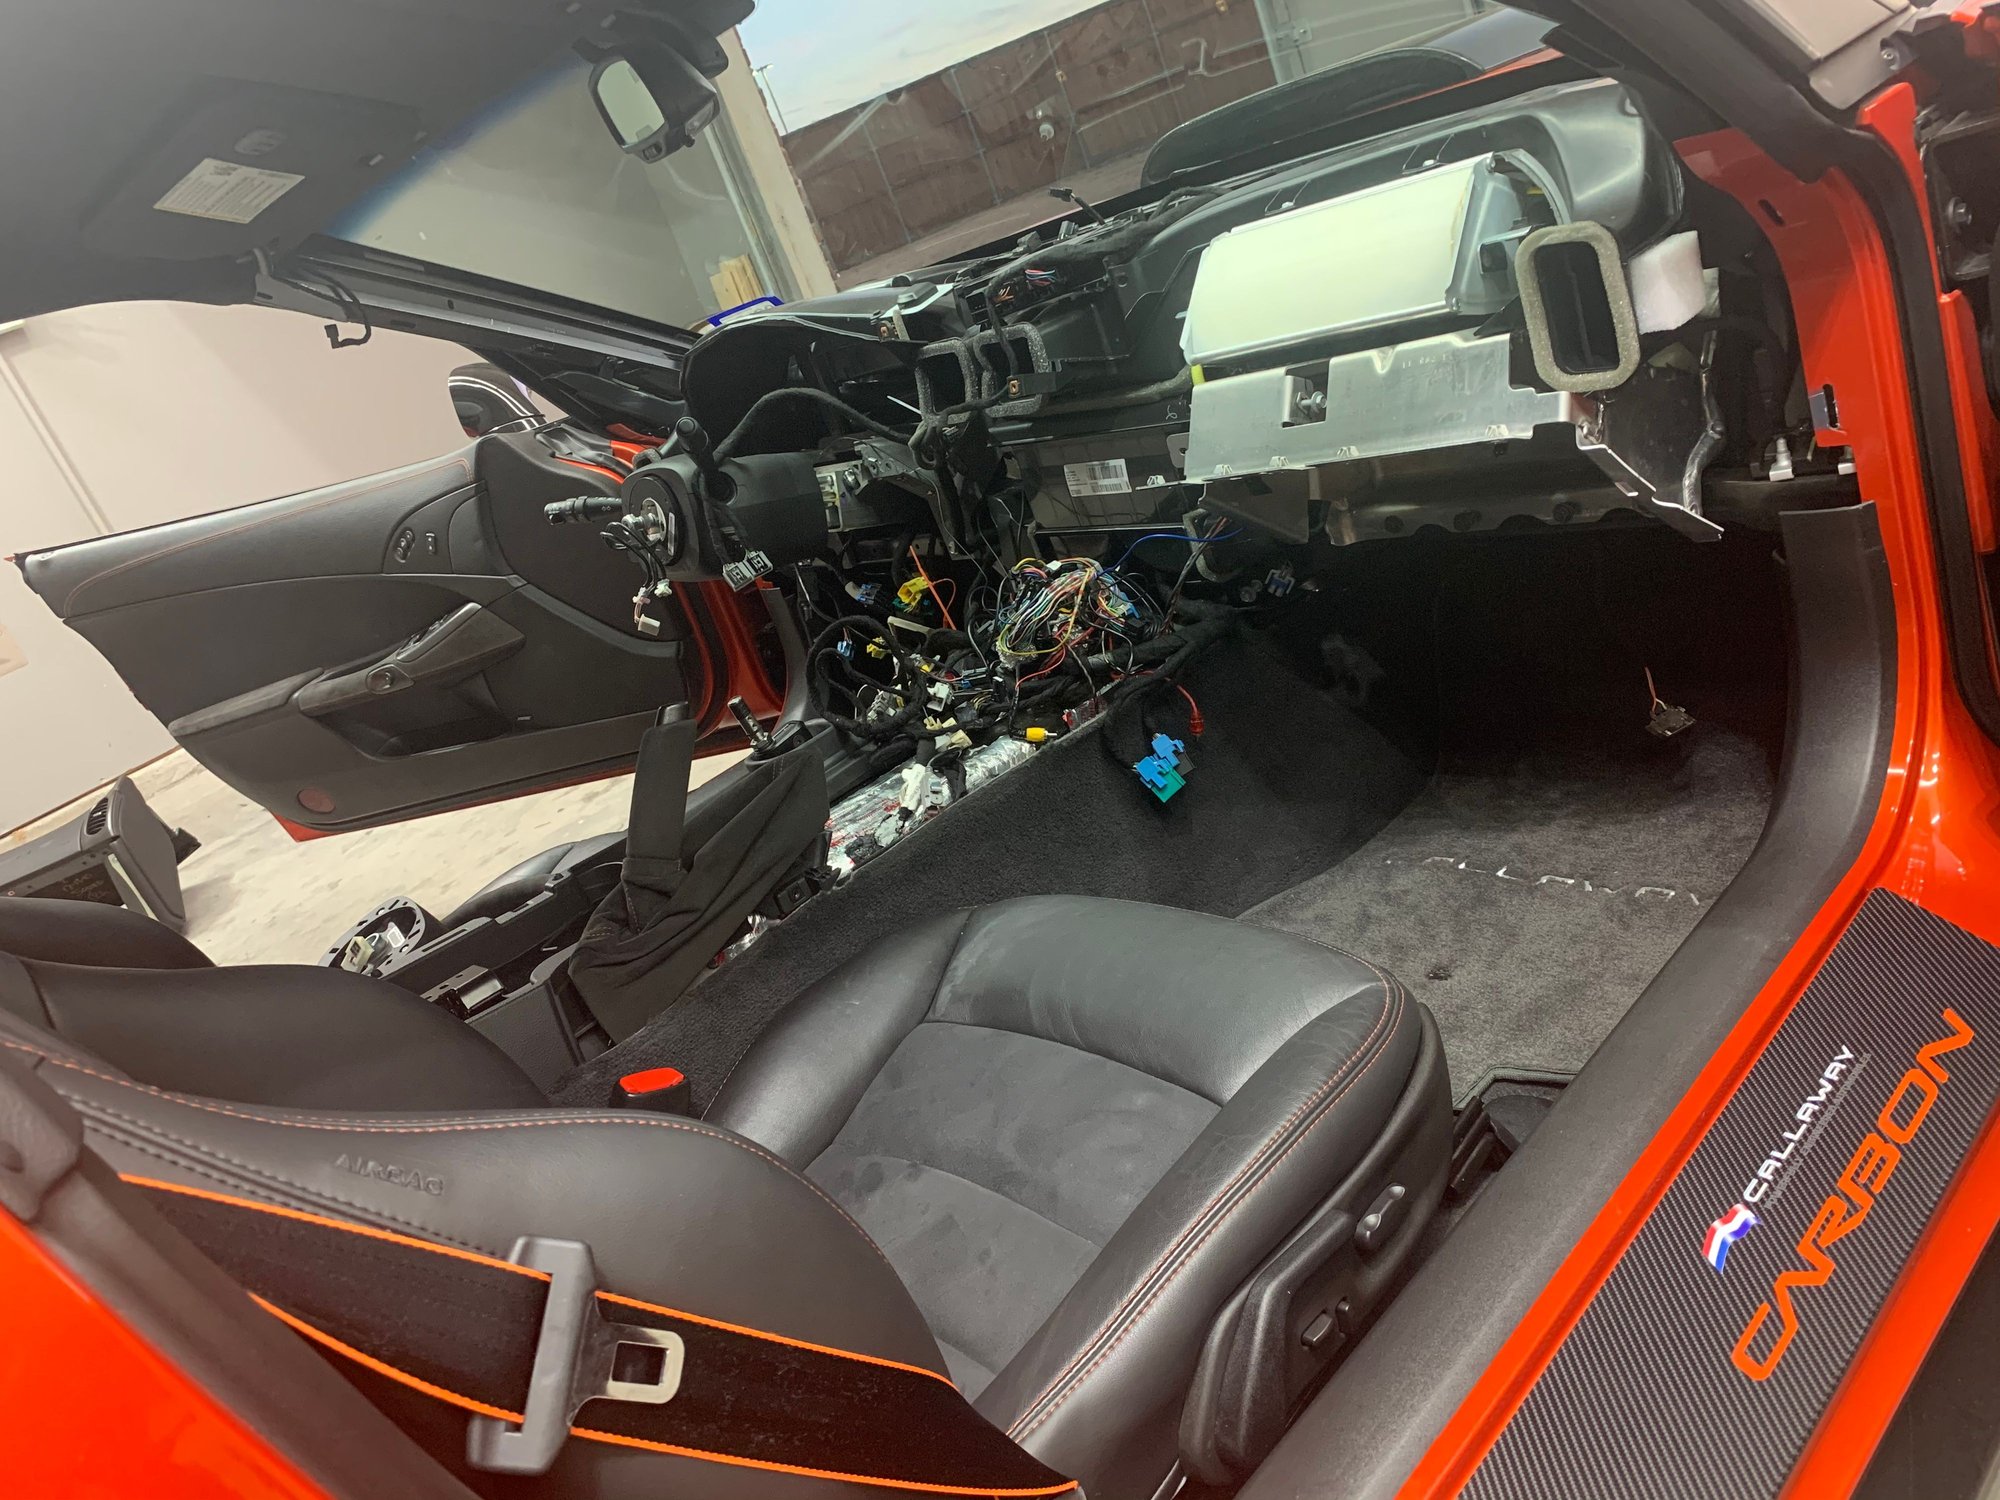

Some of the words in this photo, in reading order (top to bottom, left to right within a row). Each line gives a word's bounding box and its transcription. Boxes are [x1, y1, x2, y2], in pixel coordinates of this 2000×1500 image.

[333, 1153, 446, 1197] AIRBAG
[1732, 1008, 1974, 1381] CARBON
[1742, 1044, 1856, 1205] CALLAWAY
